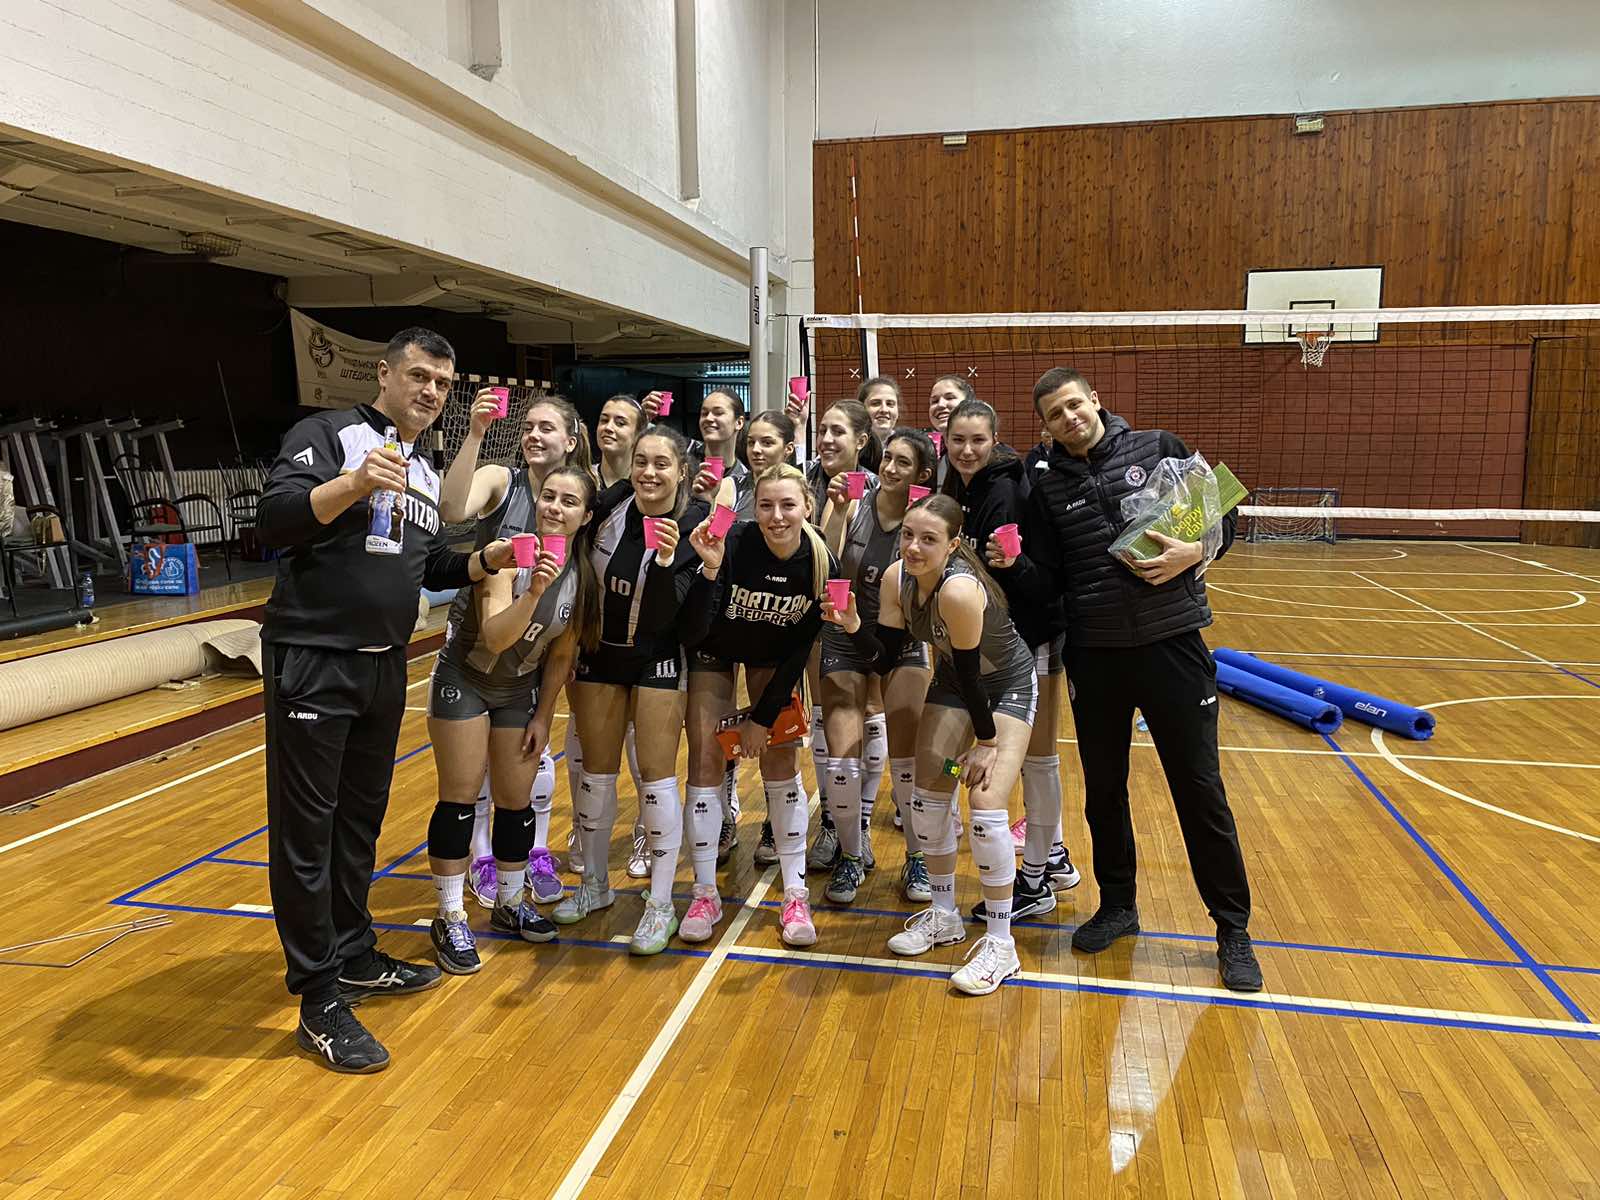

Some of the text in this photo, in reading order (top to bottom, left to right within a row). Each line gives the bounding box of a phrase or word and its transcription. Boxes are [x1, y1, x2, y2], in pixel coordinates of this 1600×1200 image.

[864, 565, 879, 583] 3
[610, 576, 632, 597] 10
[297, 712, 319, 720] ARDU
[1354, 701, 1388, 718] elan
[931, 884, 952, 893] BELE
